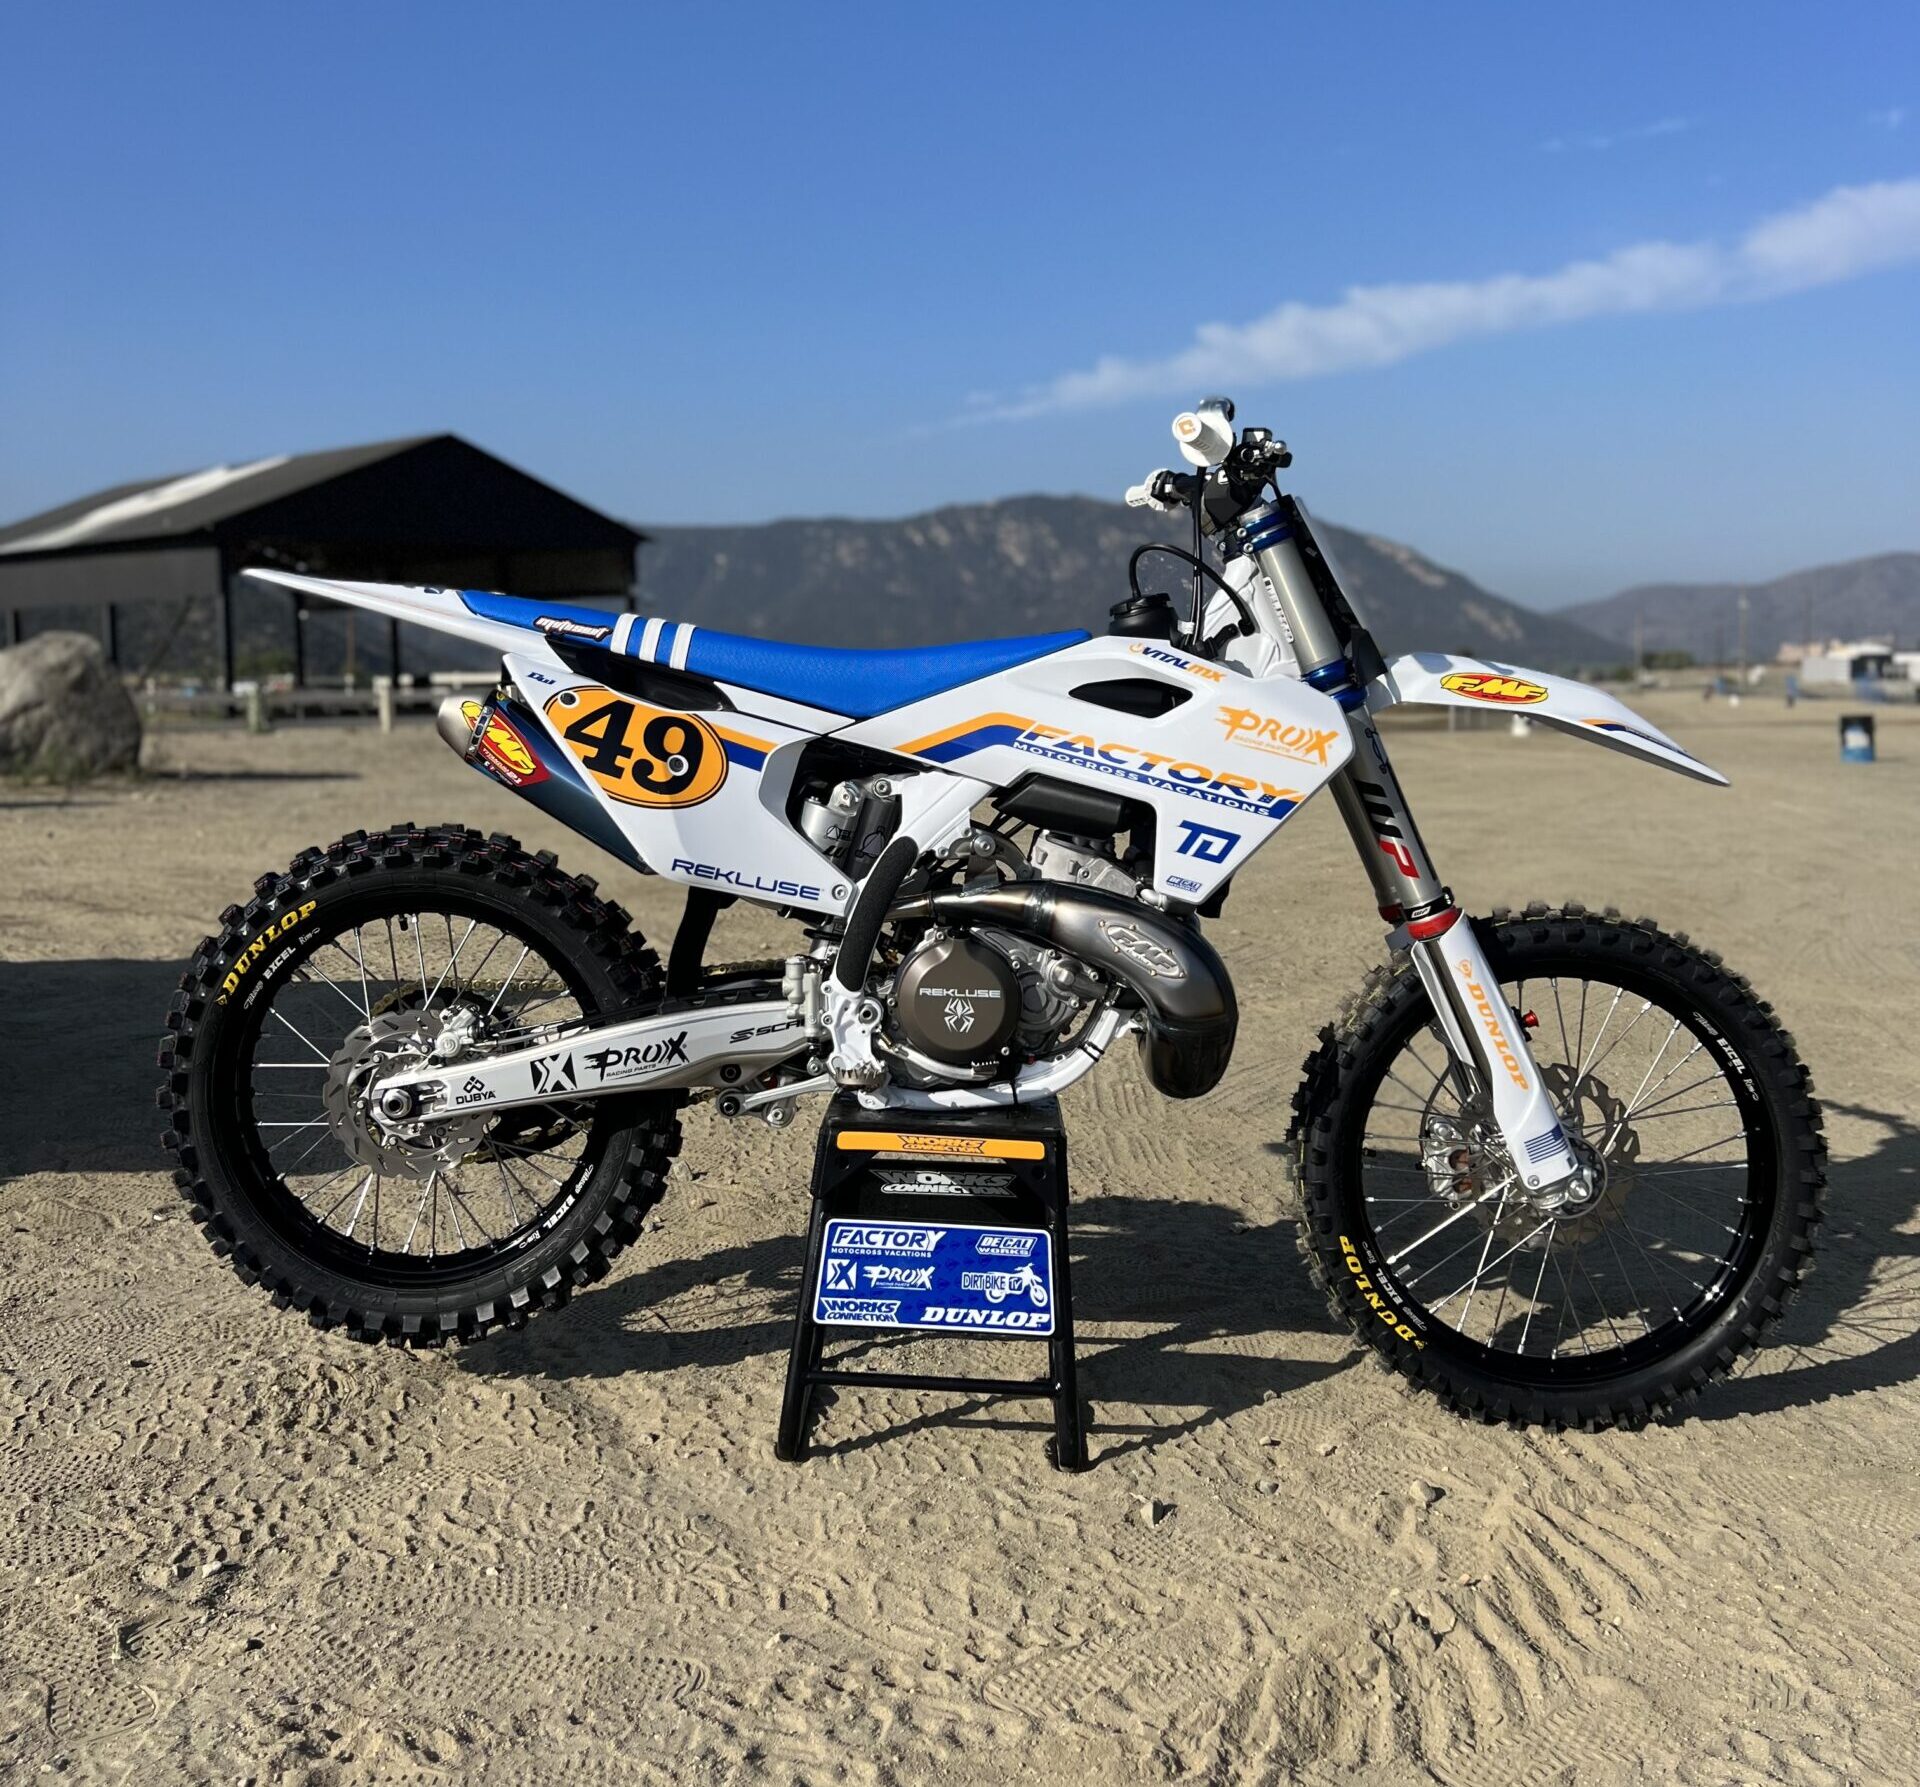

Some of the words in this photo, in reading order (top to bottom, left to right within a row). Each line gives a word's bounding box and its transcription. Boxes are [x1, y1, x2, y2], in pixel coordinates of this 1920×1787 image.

[1441, 676, 1548, 699] FMF
[563, 699, 704, 796] 49
[1020, 725, 1306, 806] FACTORY
[1012, 740, 1140, 782] MOTOCROSS
[1147, 778, 1271, 817] VACATIONS
[671, 858, 822, 900] REKLUSE
[222, 900, 317, 996] DUNLOP
[1109, 928, 1179, 972] FMF
[262, 946, 296, 980] EXCEL
[919, 988, 1001, 998] REKLUSE
[1466, 983, 1530, 1091] DUNLOP
[1716, 1037, 1746, 1075] EXCEL
[606, 1068, 633, 1077] RACING
[634, 1063, 657, 1073] PARTS
[456, 1090, 495, 1105] DUBYA
[879, 1171, 1013, 1186] WORKS
[882, 1184, 1011, 1196] CONNECTION
[542, 1194, 576, 1229] EXCEL
[833, 1229, 947, 1251] FACTORY
[980, 1236, 1034, 1249] DECAL
[831, 1247, 882, 1256] MOTOCROSS
[884, 1250, 932, 1258] VACATIONS
[978, 1247, 1029, 1256] WORKS
[962, 1273, 983, 1289] DIRT
[984, 1274, 1006, 1291] BIKE
[1339, 1235, 1417, 1341] DUNLOP
[1376, 1267, 1403, 1305] EXCEL
[824, 1300, 898, 1313] WORKS
[827, 1311, 896, 1322] CONNECTION
[920, 1307, 1050, 1328] DUNLOP
